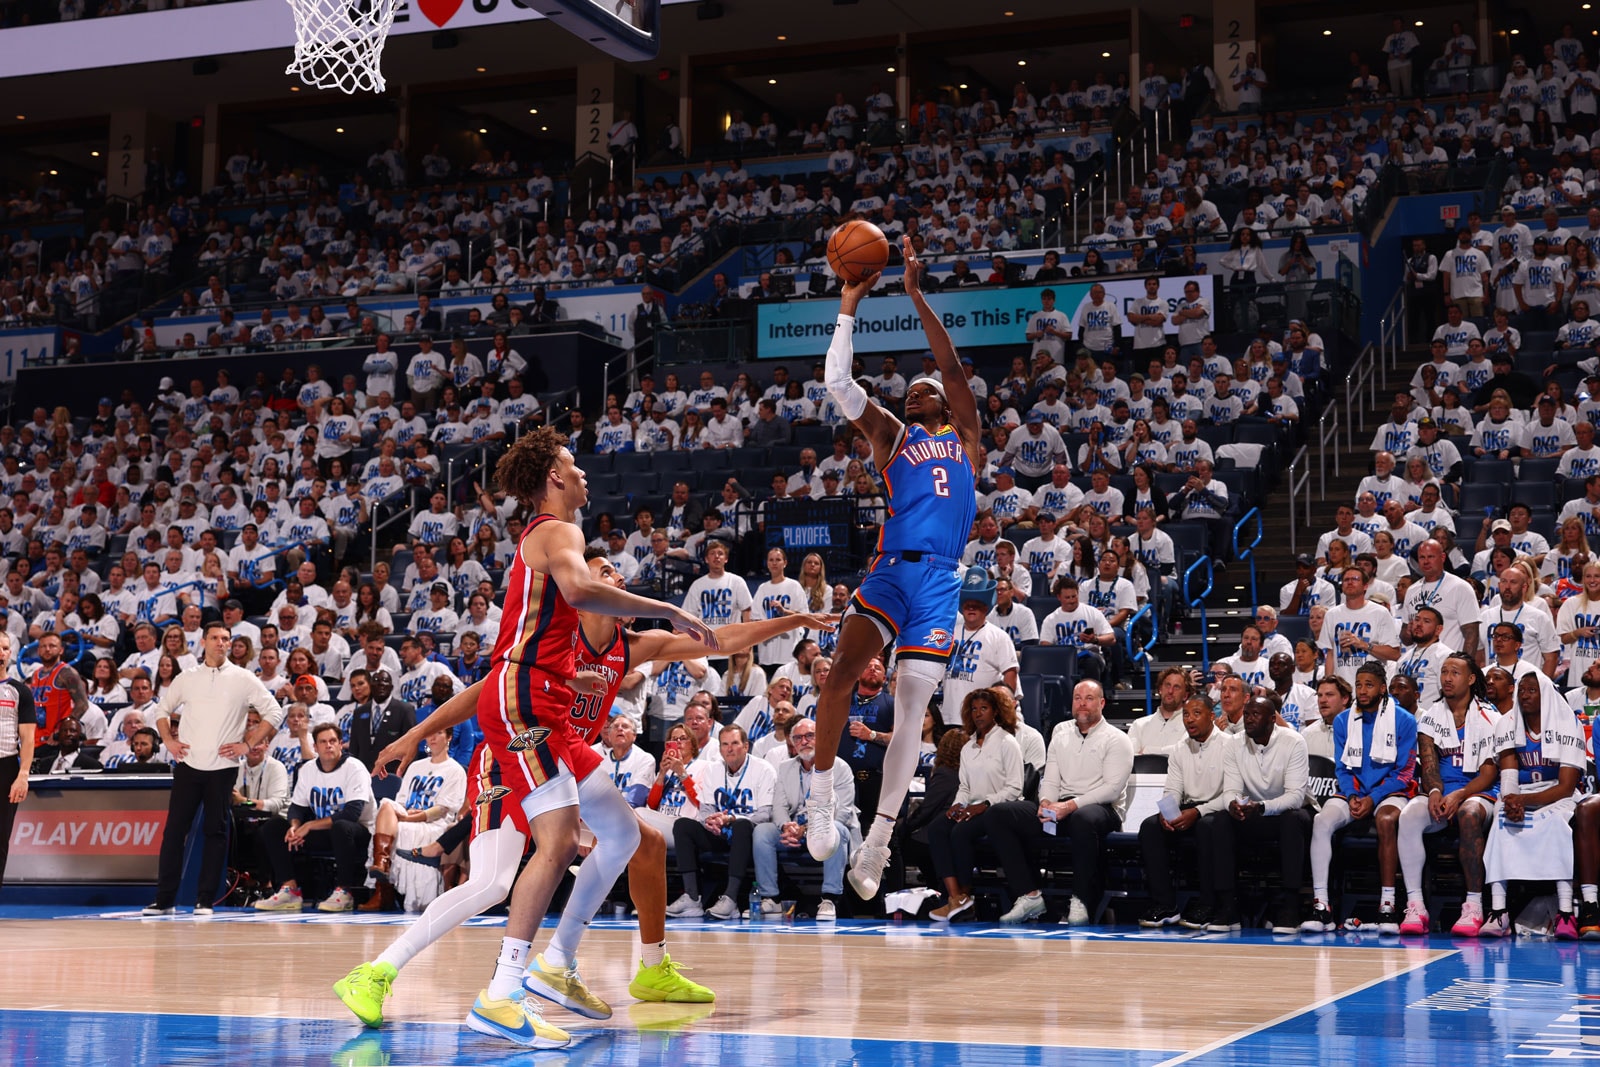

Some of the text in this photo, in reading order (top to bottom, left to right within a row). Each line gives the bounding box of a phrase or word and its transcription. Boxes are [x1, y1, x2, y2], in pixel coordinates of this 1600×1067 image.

[1455, 255, 1477, 273] OKC
[1528, 266, 1552, 286] OKC
[610, 312, 627, 332] 11
[769, 321, 835, 339] Interne
[853, 315, 924, 334] houldn
[943, 312, 966, 328] Be
[971, 308, 1010, 327] This
[1087, 311, 1109, 328] OKC
[414, 360, 433, 377] OKC
[1466, 369, 1489, 389] OKC
[324, 420, 347, 441] OKC
[602, 430, 622, 446] OKC
[1483, 430, 1510, 450] OKC
[1385, 431, 1411, 451] OKC
[1532, 436, 1560, 453] OKC
[900, 440, 963, 467] THUNDER
[1021, 441, 1047, 464] OKC
[1175, 449, 1199, 467] OKC
[1571, 458, 1599, 477] OKC
[931, 465, 951, 498] 2
[992, 494, 1018, 515] OKC
[1043, 491, 1067, 510] OKC
[289, 524, 313, 541] OKC
[422, 521, 443, 543] OKC
[783, 526, 832, 546] PLAYOFFS
[1029, 551, 1054, 573] OKC
[700, 588, 732, 619] OKC
[417, 616, 443, 633] OKC
[1056, 619, 1088, 646] OKC
[1575, 612, 1600, 650] OK
[1335, 622, 1371, 658] OKC
[401, 675, 427, 701] OKC
[1240, 671, 1265, 687] KC
[31, 686, 51, 704] KC
[570, 692, 603, 722] 50
[1560, 735, 1575, 746] CITY
[406, 775, 443, 809] OKC
[615, 772, 632, 792] KC
[1308, 776, 1338, 797] YOFFS
[310, 786, 344, 819] OKC
[714, 787, 753, 814] OKC
[13, 821, 160, 846] PLAY NOW
